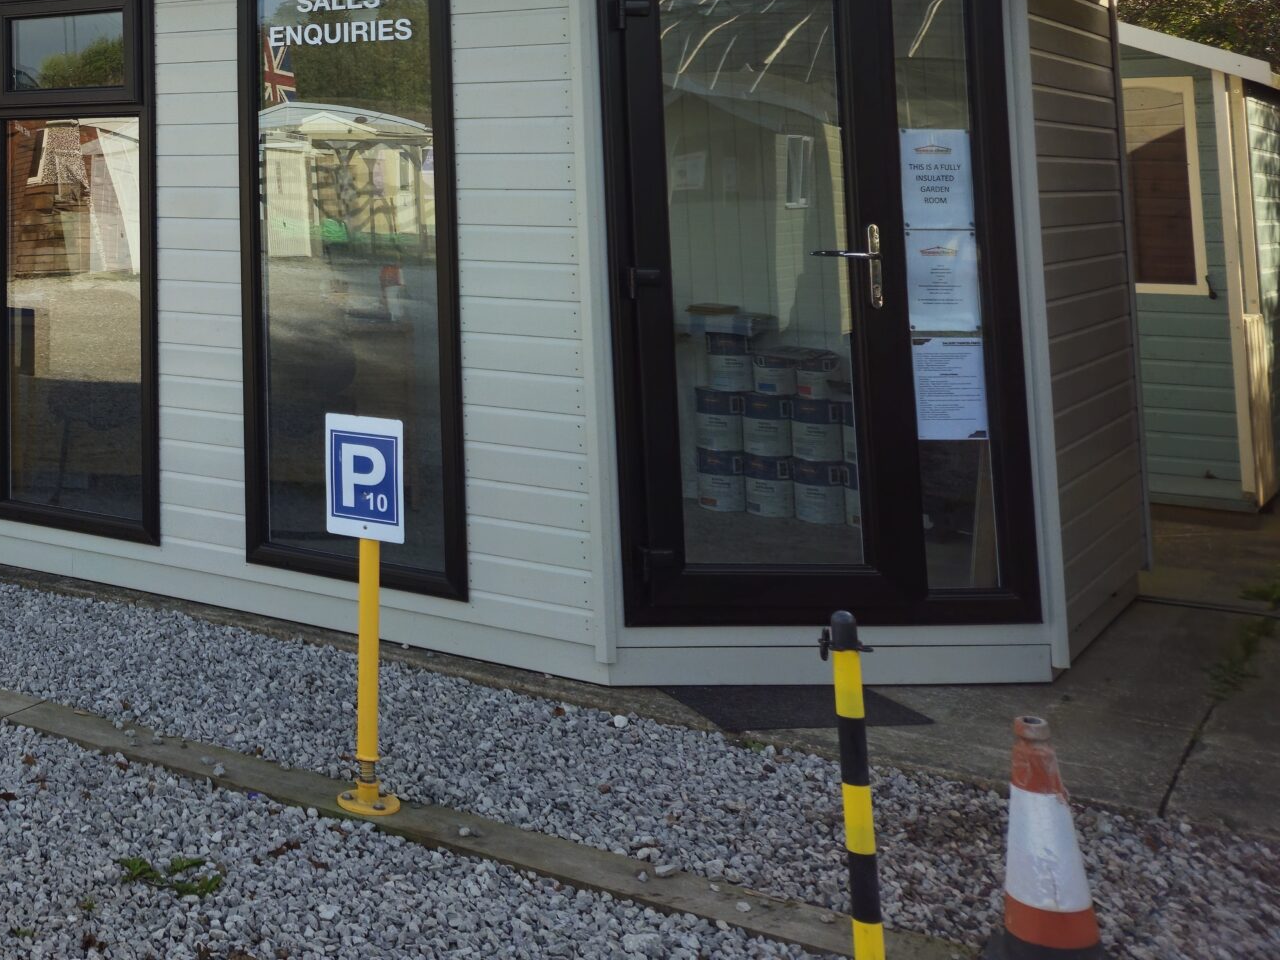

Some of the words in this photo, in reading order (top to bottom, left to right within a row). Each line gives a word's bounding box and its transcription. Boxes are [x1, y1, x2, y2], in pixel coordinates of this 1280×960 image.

[270, 18, 413, 47] ENQUIRIES
[908, 163, 924, 171] THIS
[926, 163, 932, 171] IS
[934, 163, 939, 171] A
[940, 163, 961, 171] FULLY
[915, 174, 955, 182] INSULATED
[920, 185, 950, 193] GARDEN
[341, 442, 387, 508] P
[366, 492, 388, 512] 10
